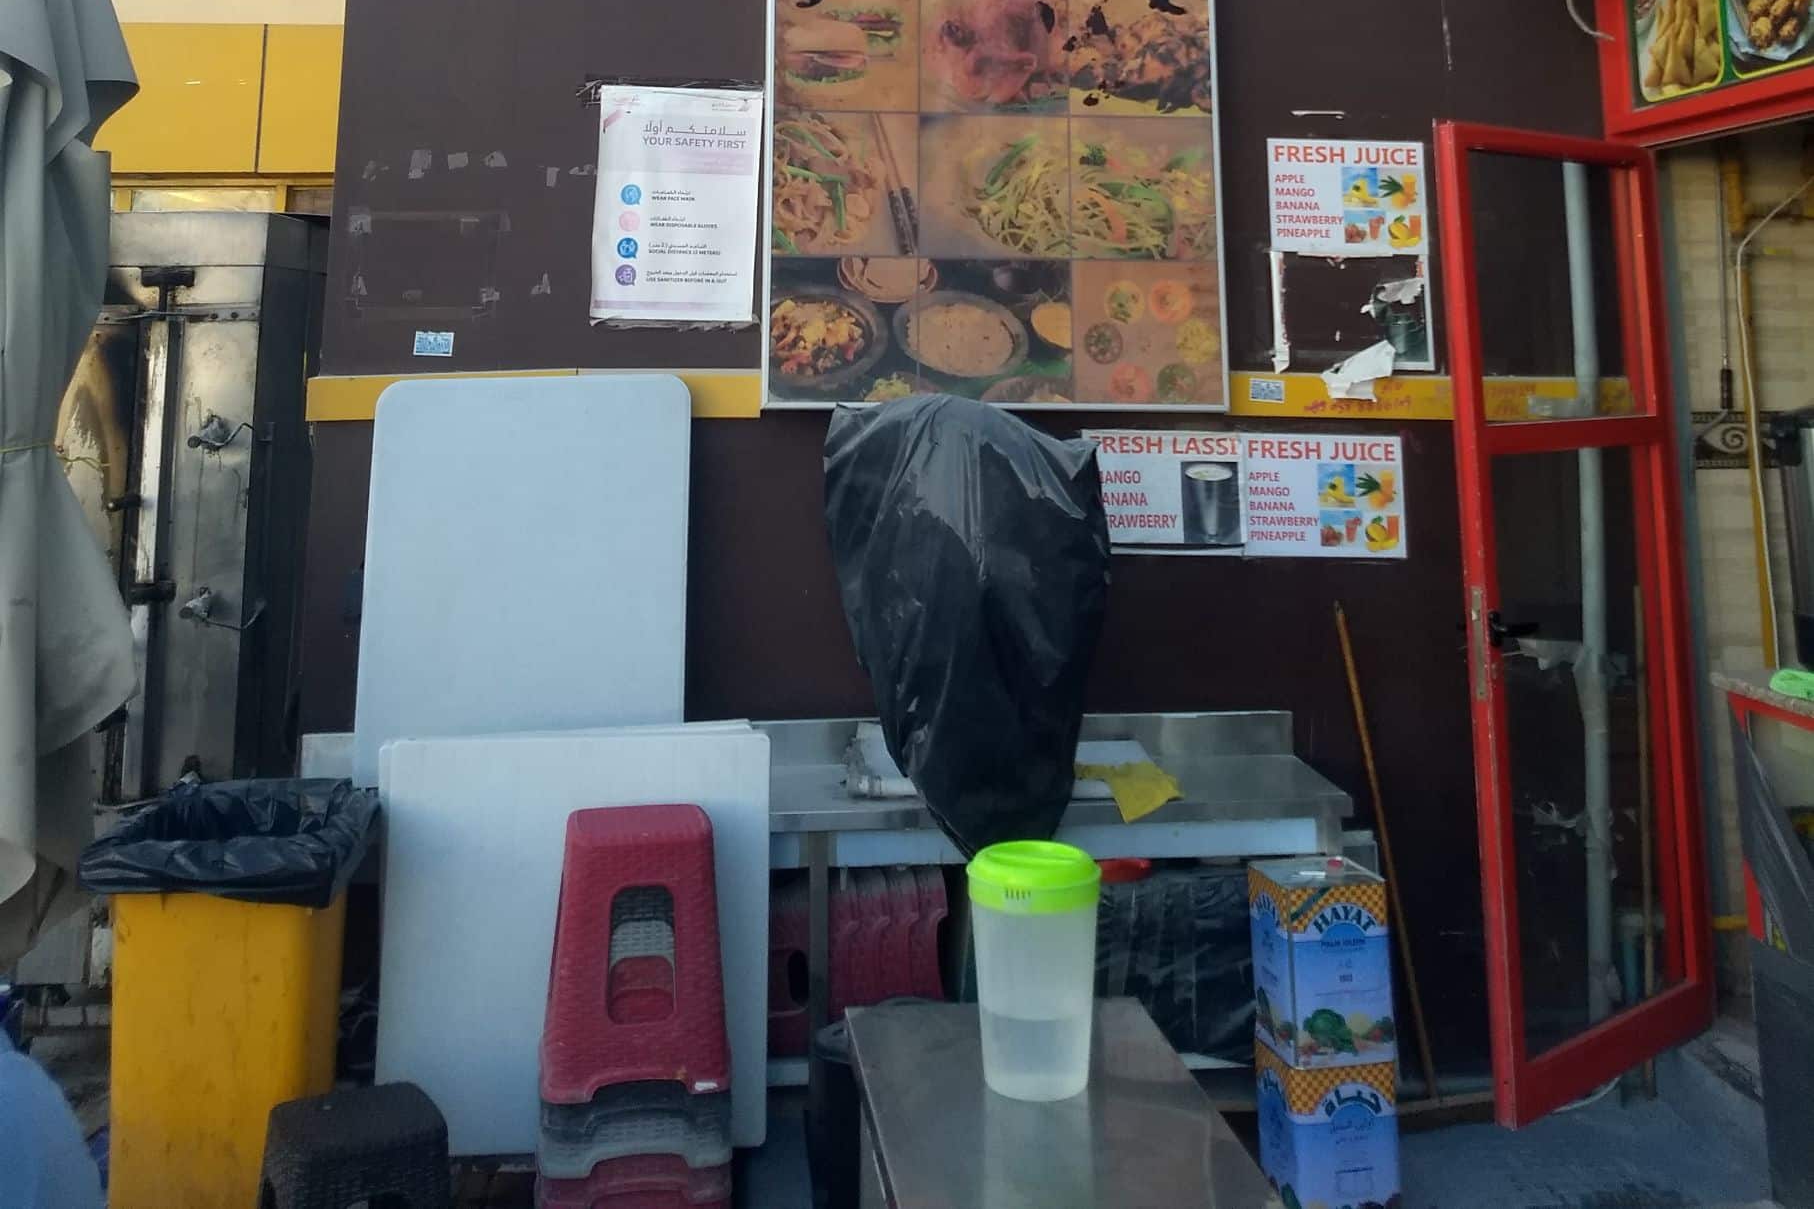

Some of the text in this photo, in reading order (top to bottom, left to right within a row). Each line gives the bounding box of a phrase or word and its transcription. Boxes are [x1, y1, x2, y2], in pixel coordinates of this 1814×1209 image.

[643, 136, 746, 149] YOUR SAFETY FIRST
[1273, 145, 1418, 166] FRESH JUICE
[1275, 174, 1305, 184] APPLE
[1275, 188, 1315, 197] MANGO
[1275, 201, 1320, 211] BANANA
[1276, 215, 1344, 225] STRAWBERRY
[1277, 228, 1331, 238] PINEAPPLE
[1172, 436, 1238, 456] LASSI
[1247, 440, 1396, 462] FRESH JUICE
[1249, 472, 1280, 483] APPLE
[1249, 486, 1290, 497] MANGO
[1103, 492, 1148, 507] ANANA
[1249, 501, 1295, 512] BANANA
[1106, 514, 1177, 529] RAWBERRY
[1249, 516, 1319, 527] STRAWBERRY
[1250, 530, 1306, 541] PINEAPPLE
[1313, 905, 1377, 934] HAYAT
